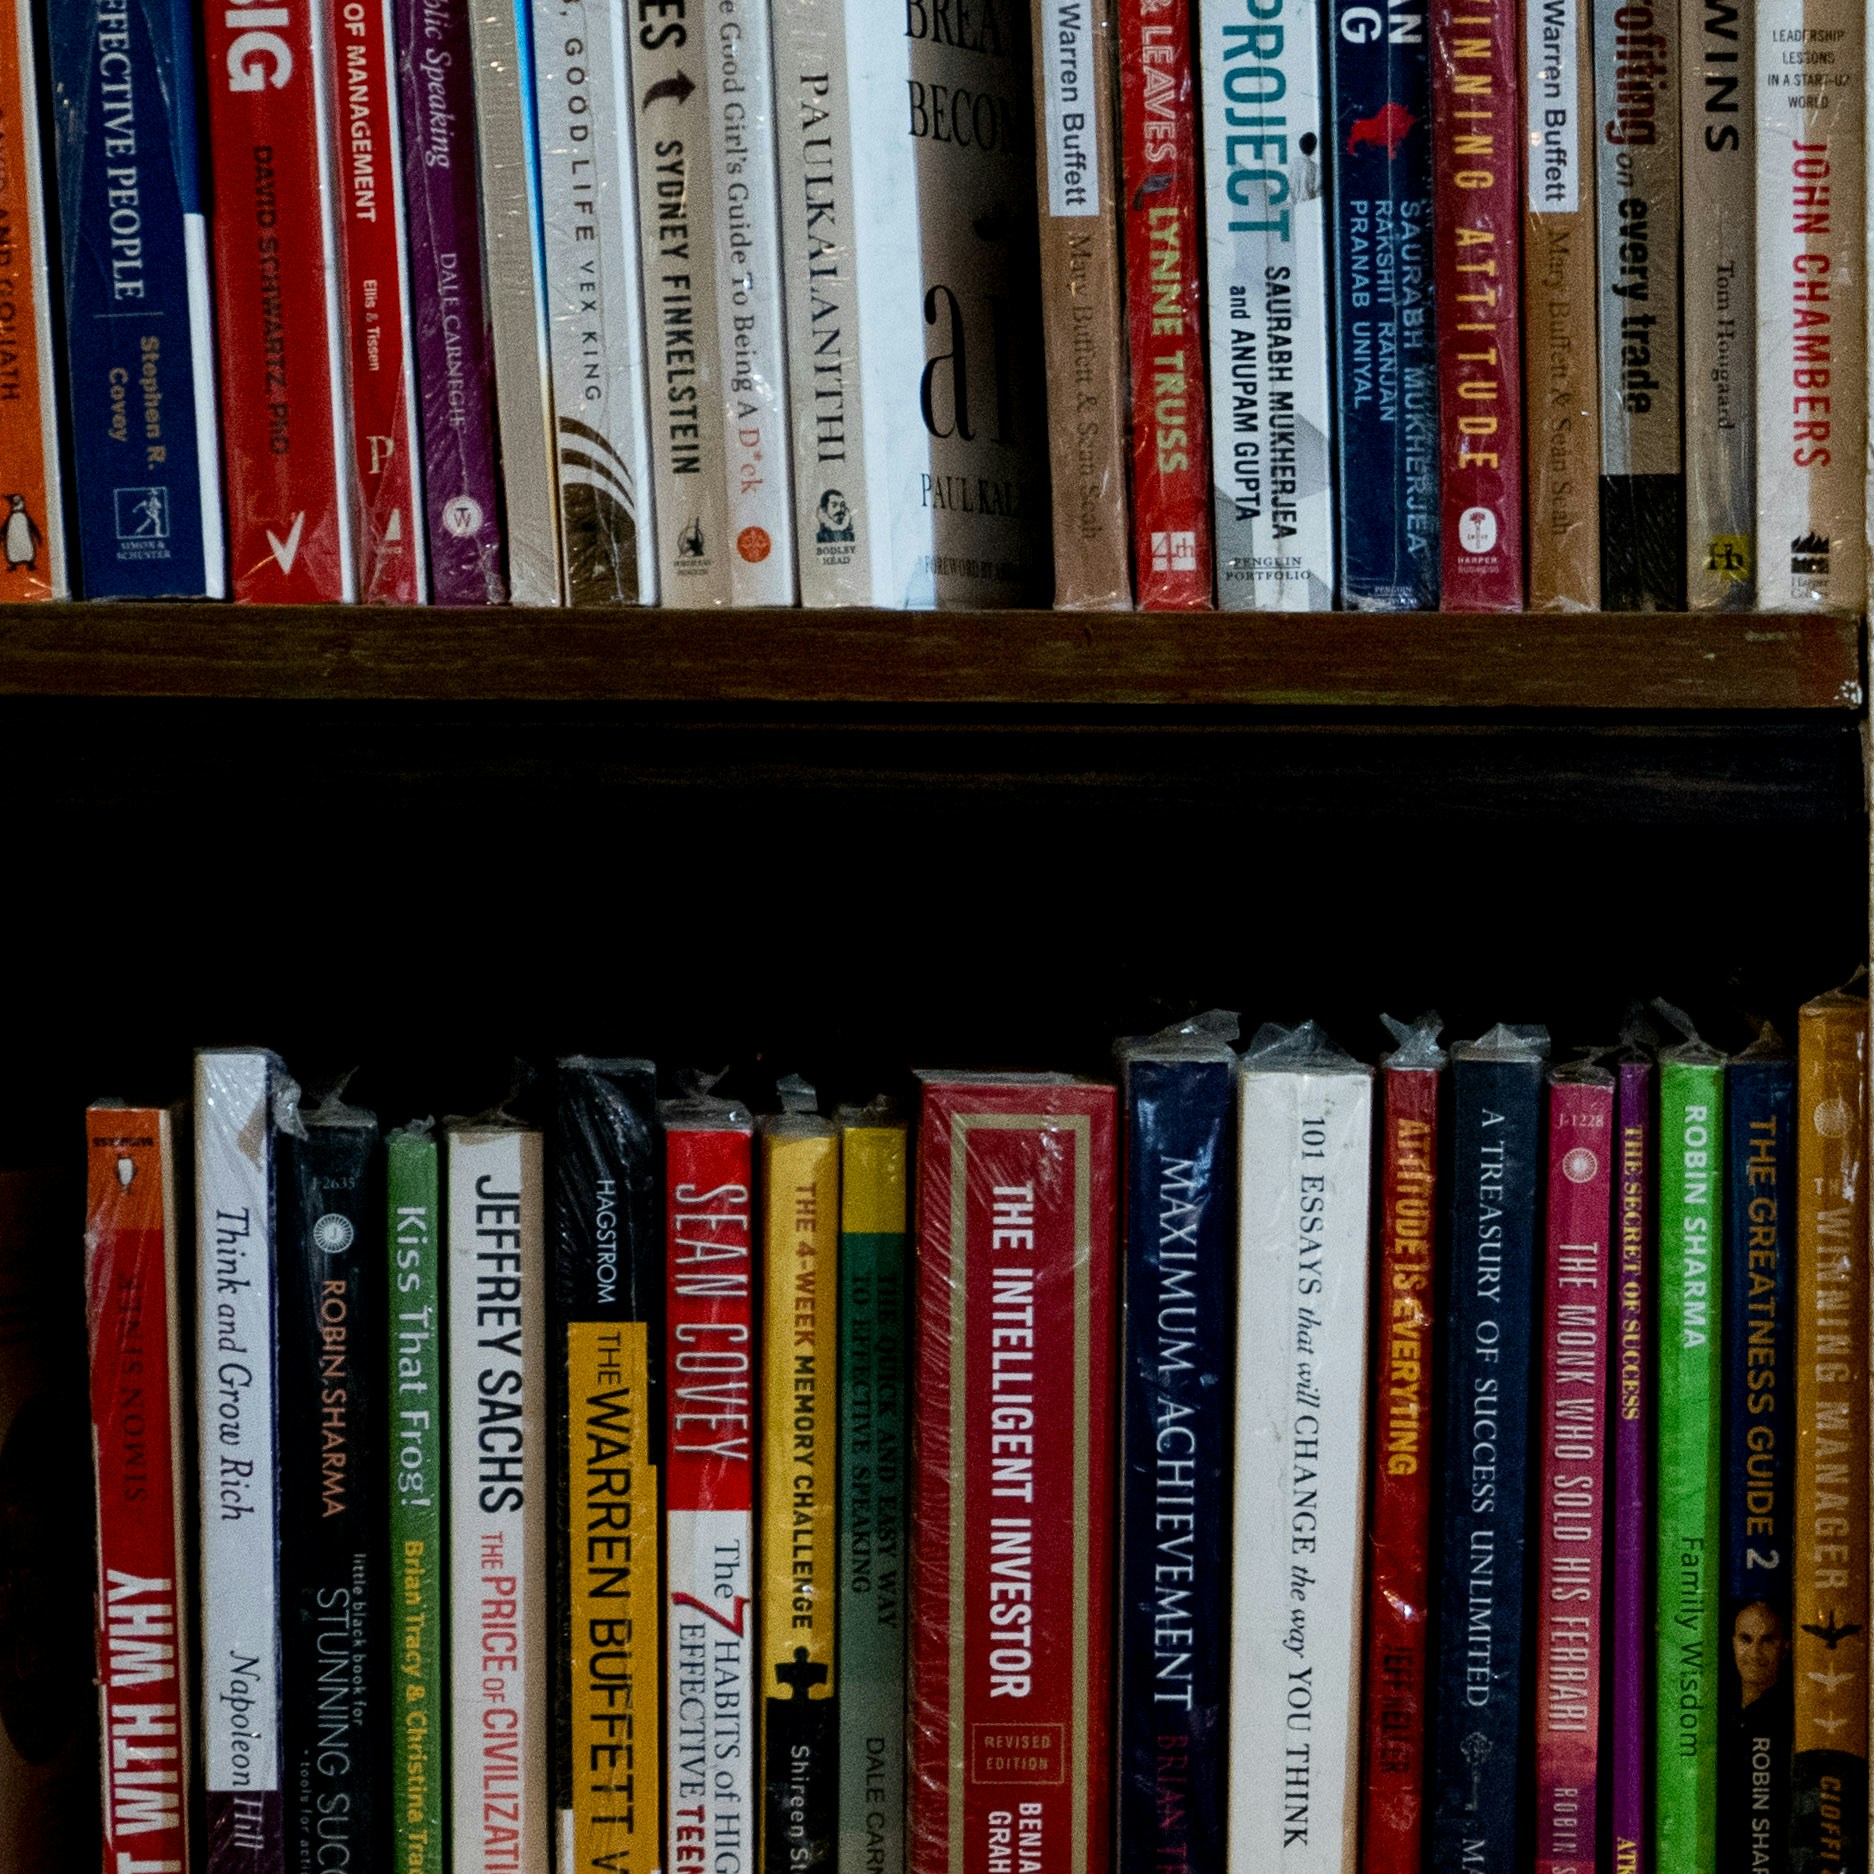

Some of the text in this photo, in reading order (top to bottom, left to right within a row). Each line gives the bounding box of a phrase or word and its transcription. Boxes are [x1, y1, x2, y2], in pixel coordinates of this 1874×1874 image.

[344, 4, 377, 222] OF MANAGEMENT
[564, 37, 601, 402] GOOD LIFE VEX KING
[106, 163, 147, 303] PEOPLE
[363, 279, 378, 308] Ellis
[655, 140, 700, 474] SYDNEY FINKELSTEIN
[1146, 207, 1188, 473] LYNNE TRUSS
[1792, 141, 1832, 468] JOHN CHAMBERS
[109, 367, 128, 443] Covey
[140, 336, 168, 472] Stephen R.
[367, 326, 381, 372] Tissen
[1229, 286, 1261, 521] and ANUPAM GUPTA
[1264, 266, 1298, 540] SAURABH MUKHERJEA
[1225, 570, 1312, 582] PORTFOLIO
[1232, 557, 1302, 568] PENGUIN
[475, 1175, 524, 1513] JEFFREY SACHS
[596, 1180, 616, 1304] HAGSTROM
[674, 1184, 749, 1461] SEAN COVEY
[215, 1208, 254, 1521] Think and Grow Rich
[397, 1206, 434, 1509] Kiss That Frog!
[990, 1185, 1034, 1699] THE INTELLIGENT INVESTOR
[1153, 1156, 1198, 1711] MAXIMUM ACHIEVEMENT
[1283, 1117, 1325, 1849] 101 ESSAYS that will CHANGE the way YOU THINK
[107, 1570, 175, 1687] WHY
[111, 1703, 182, 1836] WITH
[221, 1650, 264, 1850] Napoleon Hill
[791, 1745, 810, 1841] Shireen
